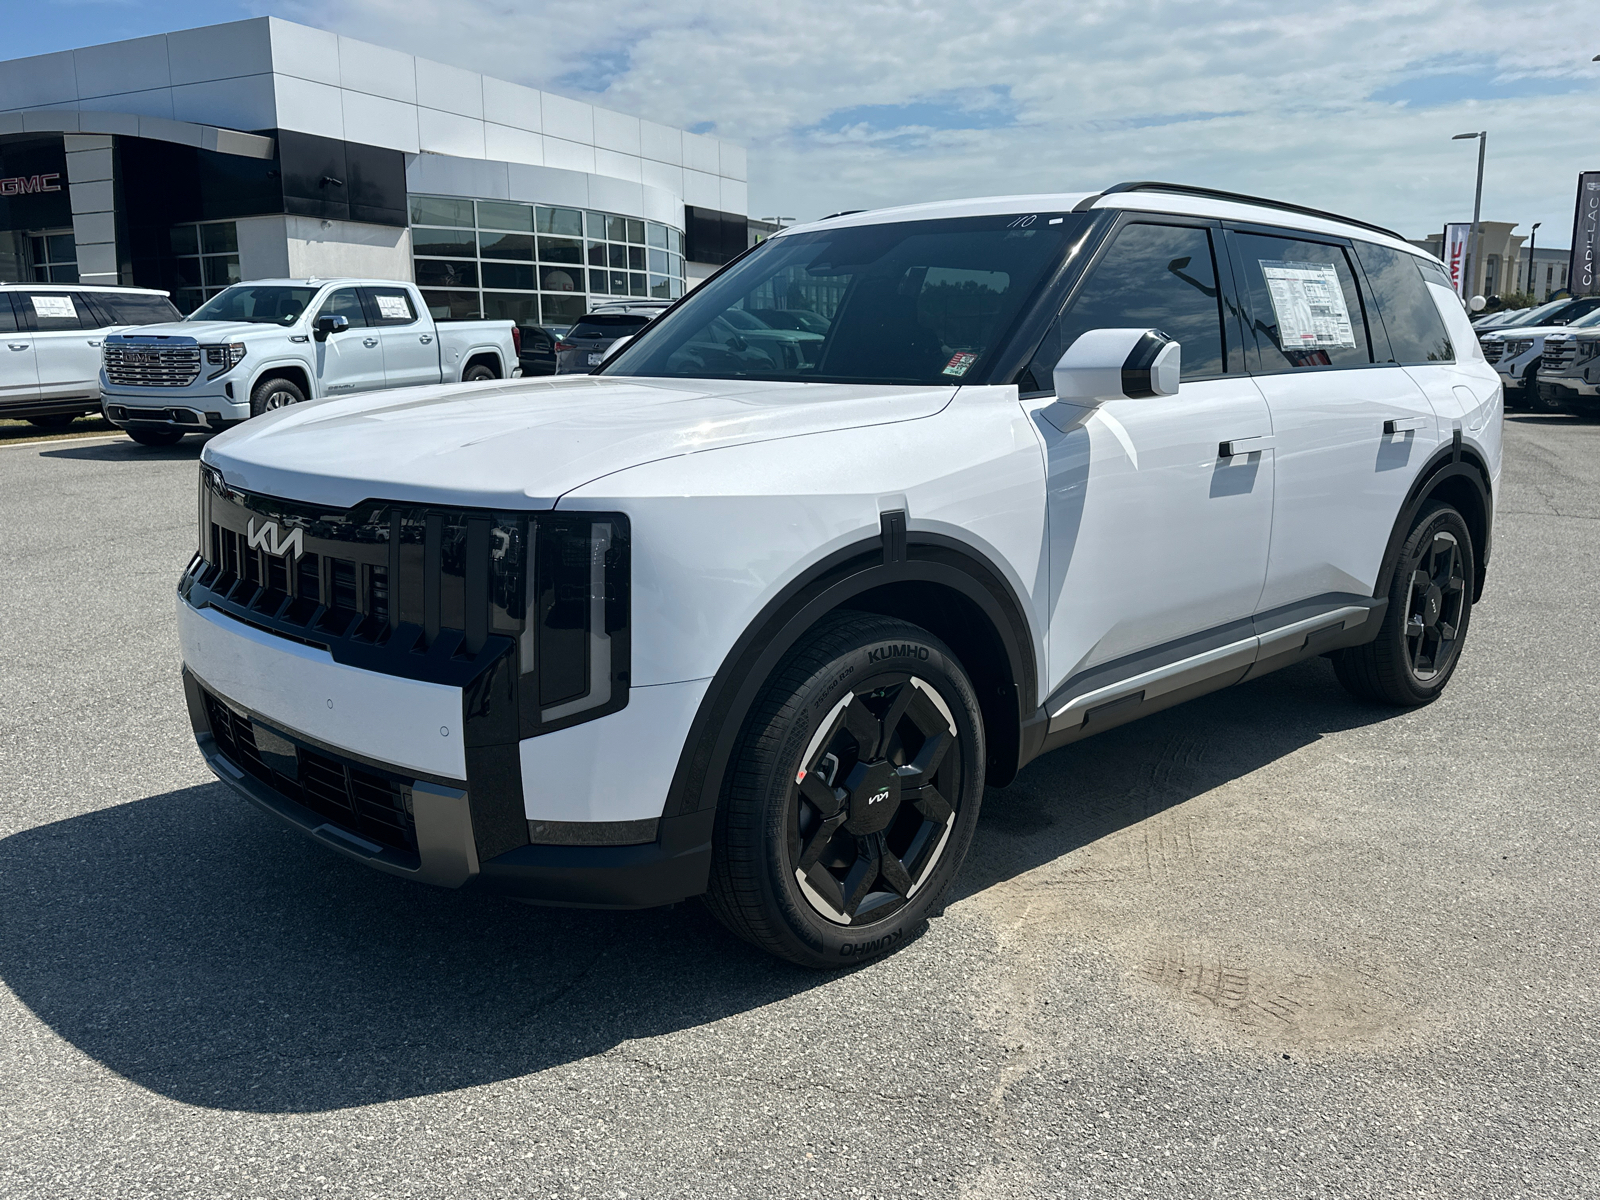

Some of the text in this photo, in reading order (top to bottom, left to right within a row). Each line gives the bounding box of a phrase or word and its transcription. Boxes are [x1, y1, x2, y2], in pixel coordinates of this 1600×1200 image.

[0, 173, 61, 196] GMC
[1582, 197, 1599, 286] CADILLAC
[124, 352, 159, 363] GMC
[247, 515, 304, 561] KIA
[867, 644, 930, 665] KUMHO
[814, 665, 855, 709] 255/50 R20
[868, 791, 889, 805] KIA
[840, 927, 904, 957] KUMHO
